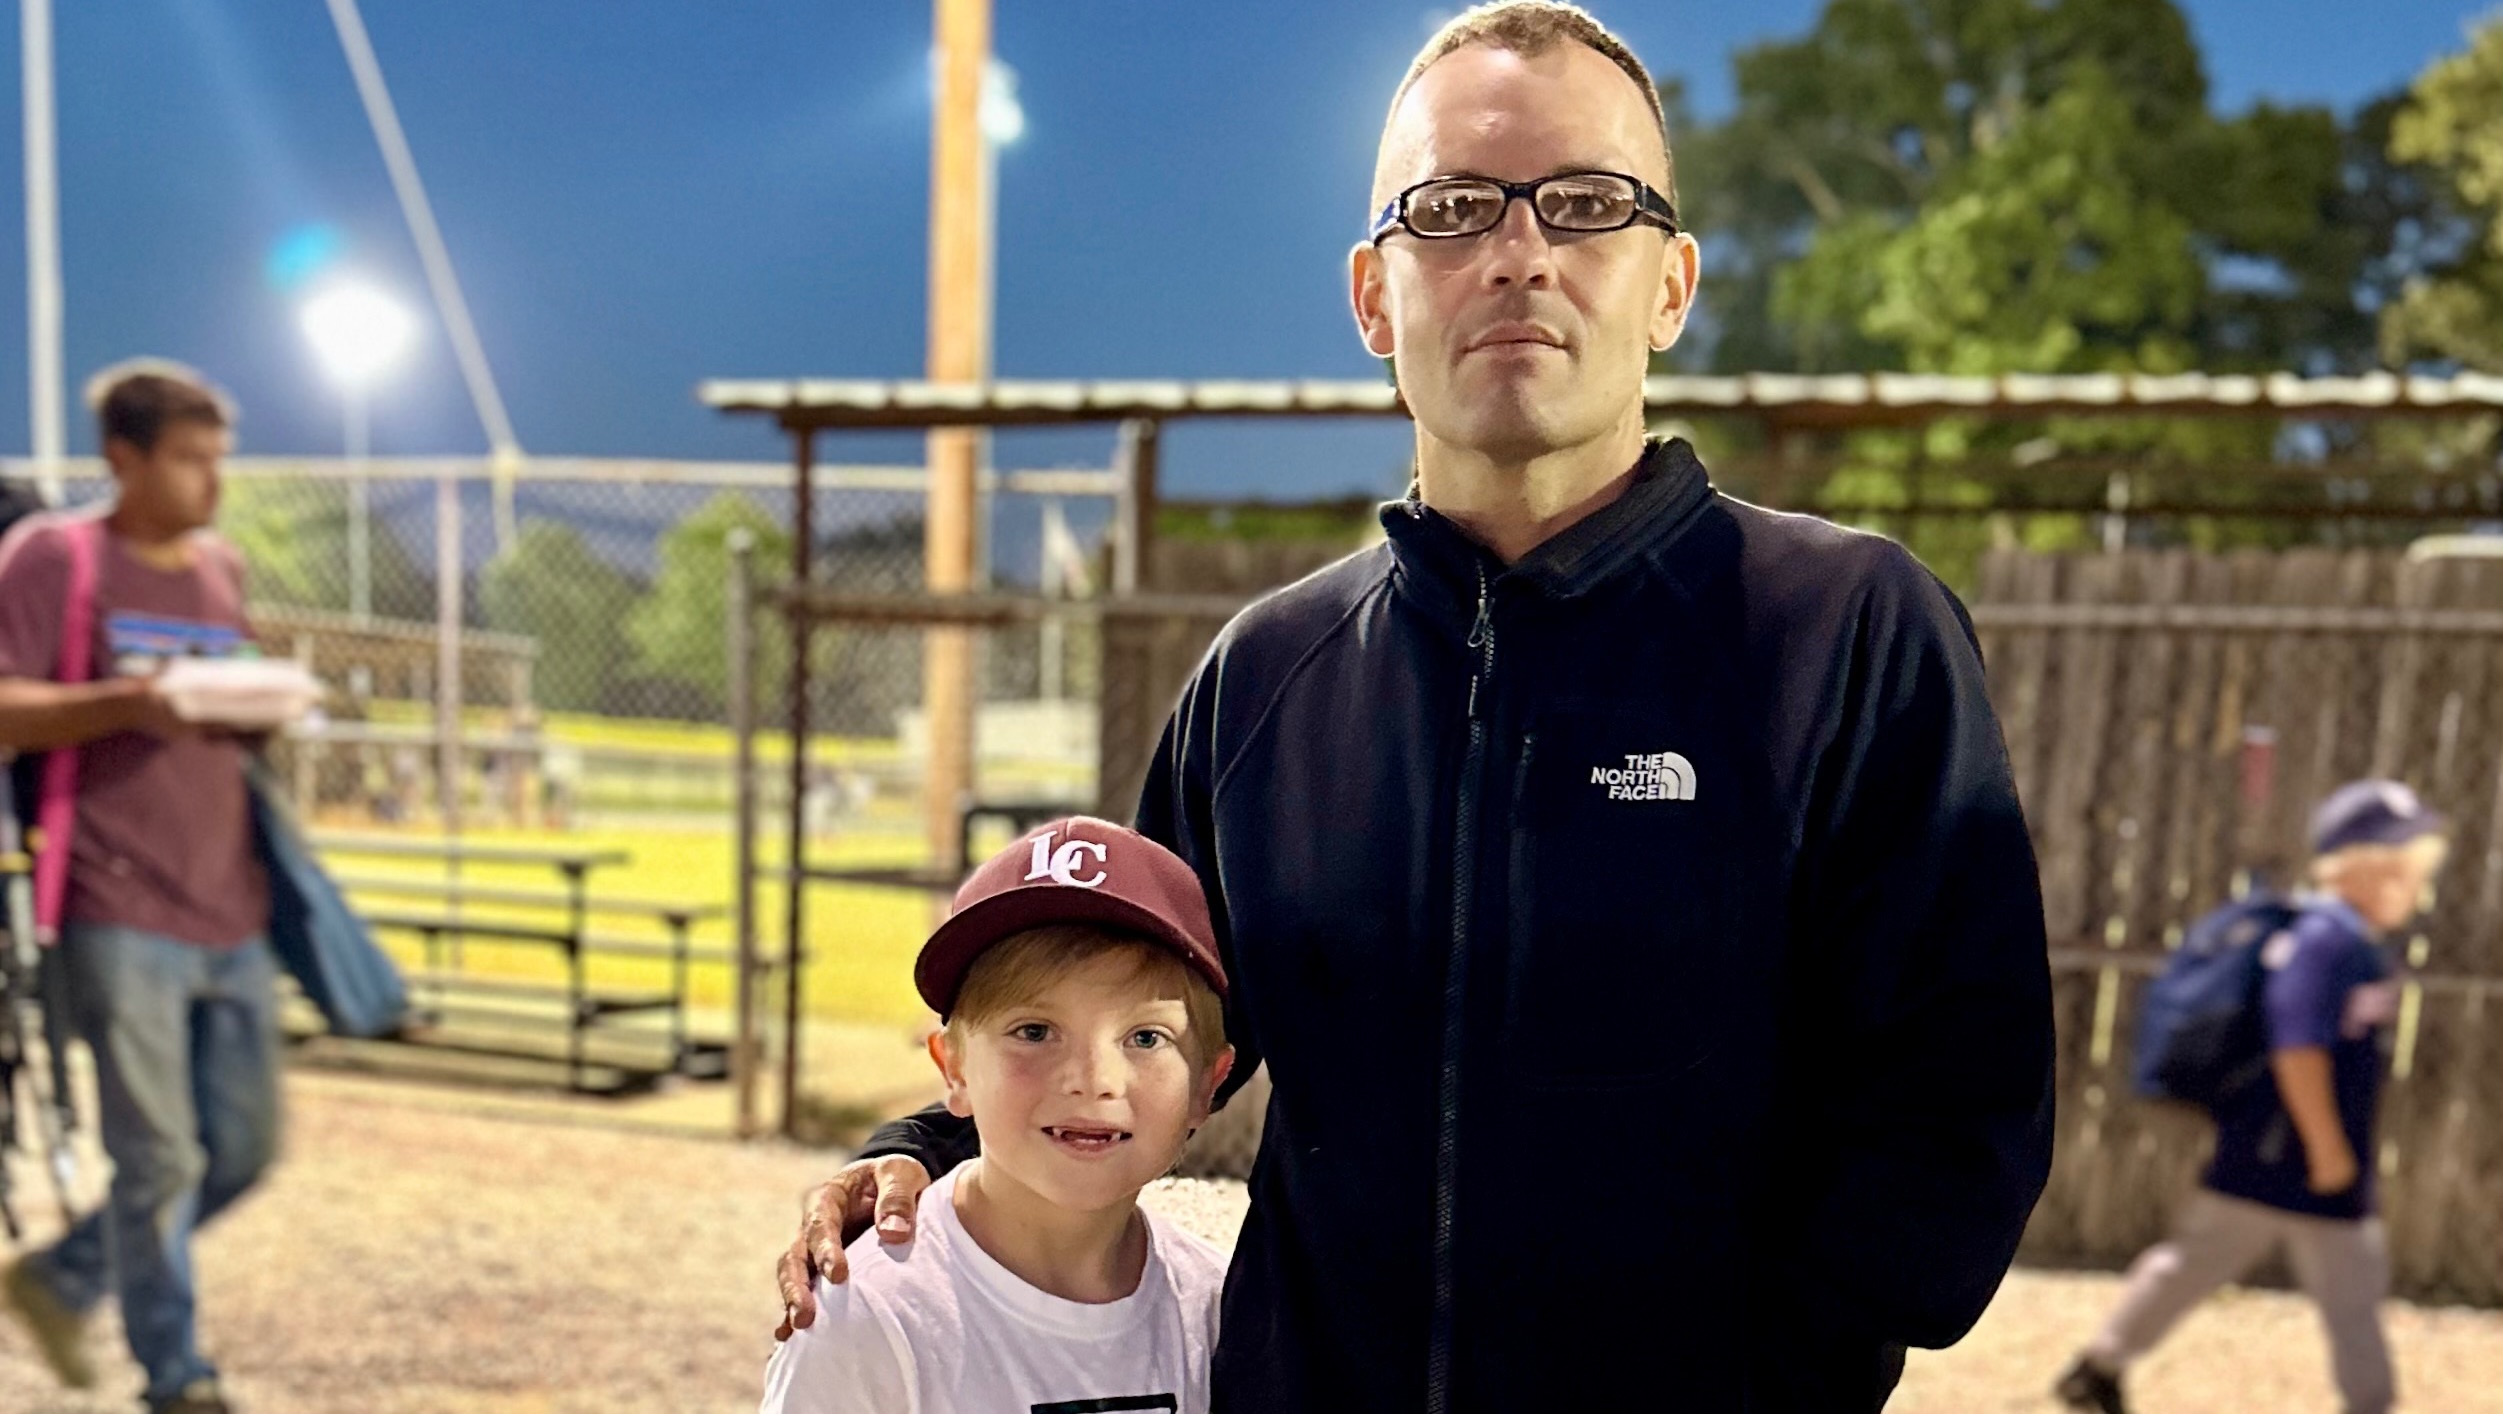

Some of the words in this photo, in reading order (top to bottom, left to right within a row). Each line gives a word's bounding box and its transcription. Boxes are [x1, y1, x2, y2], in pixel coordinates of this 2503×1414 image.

[1624, 754, 1663, 769] THE
[1591, 766, 1660, 785] NORTH
[1608, 785, 1659, 800] FACE
[1024, 830, 1107, 887] LC
